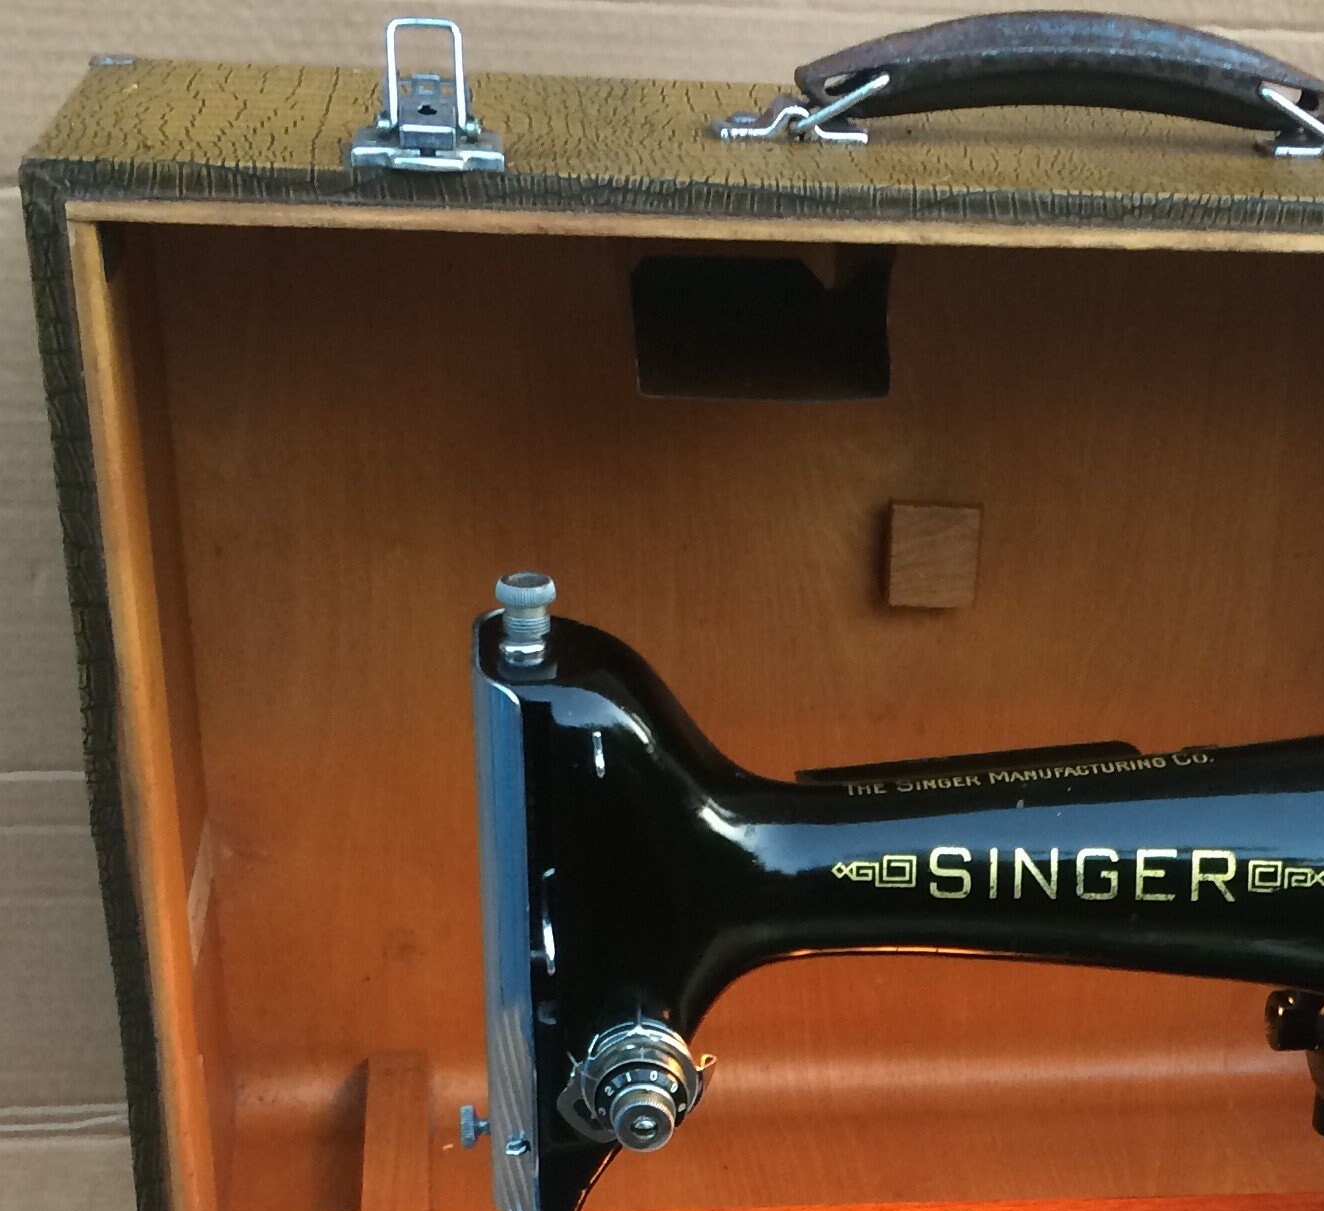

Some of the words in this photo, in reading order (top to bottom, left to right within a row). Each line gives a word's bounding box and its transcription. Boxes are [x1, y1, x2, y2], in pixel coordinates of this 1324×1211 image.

[846, 782, 887, 797] THE
[896, 775, 982, 793] SINGER
[987, 756, 1168, 785] MANUFACTURING
[928, 844, 1237, 903] SINGER
